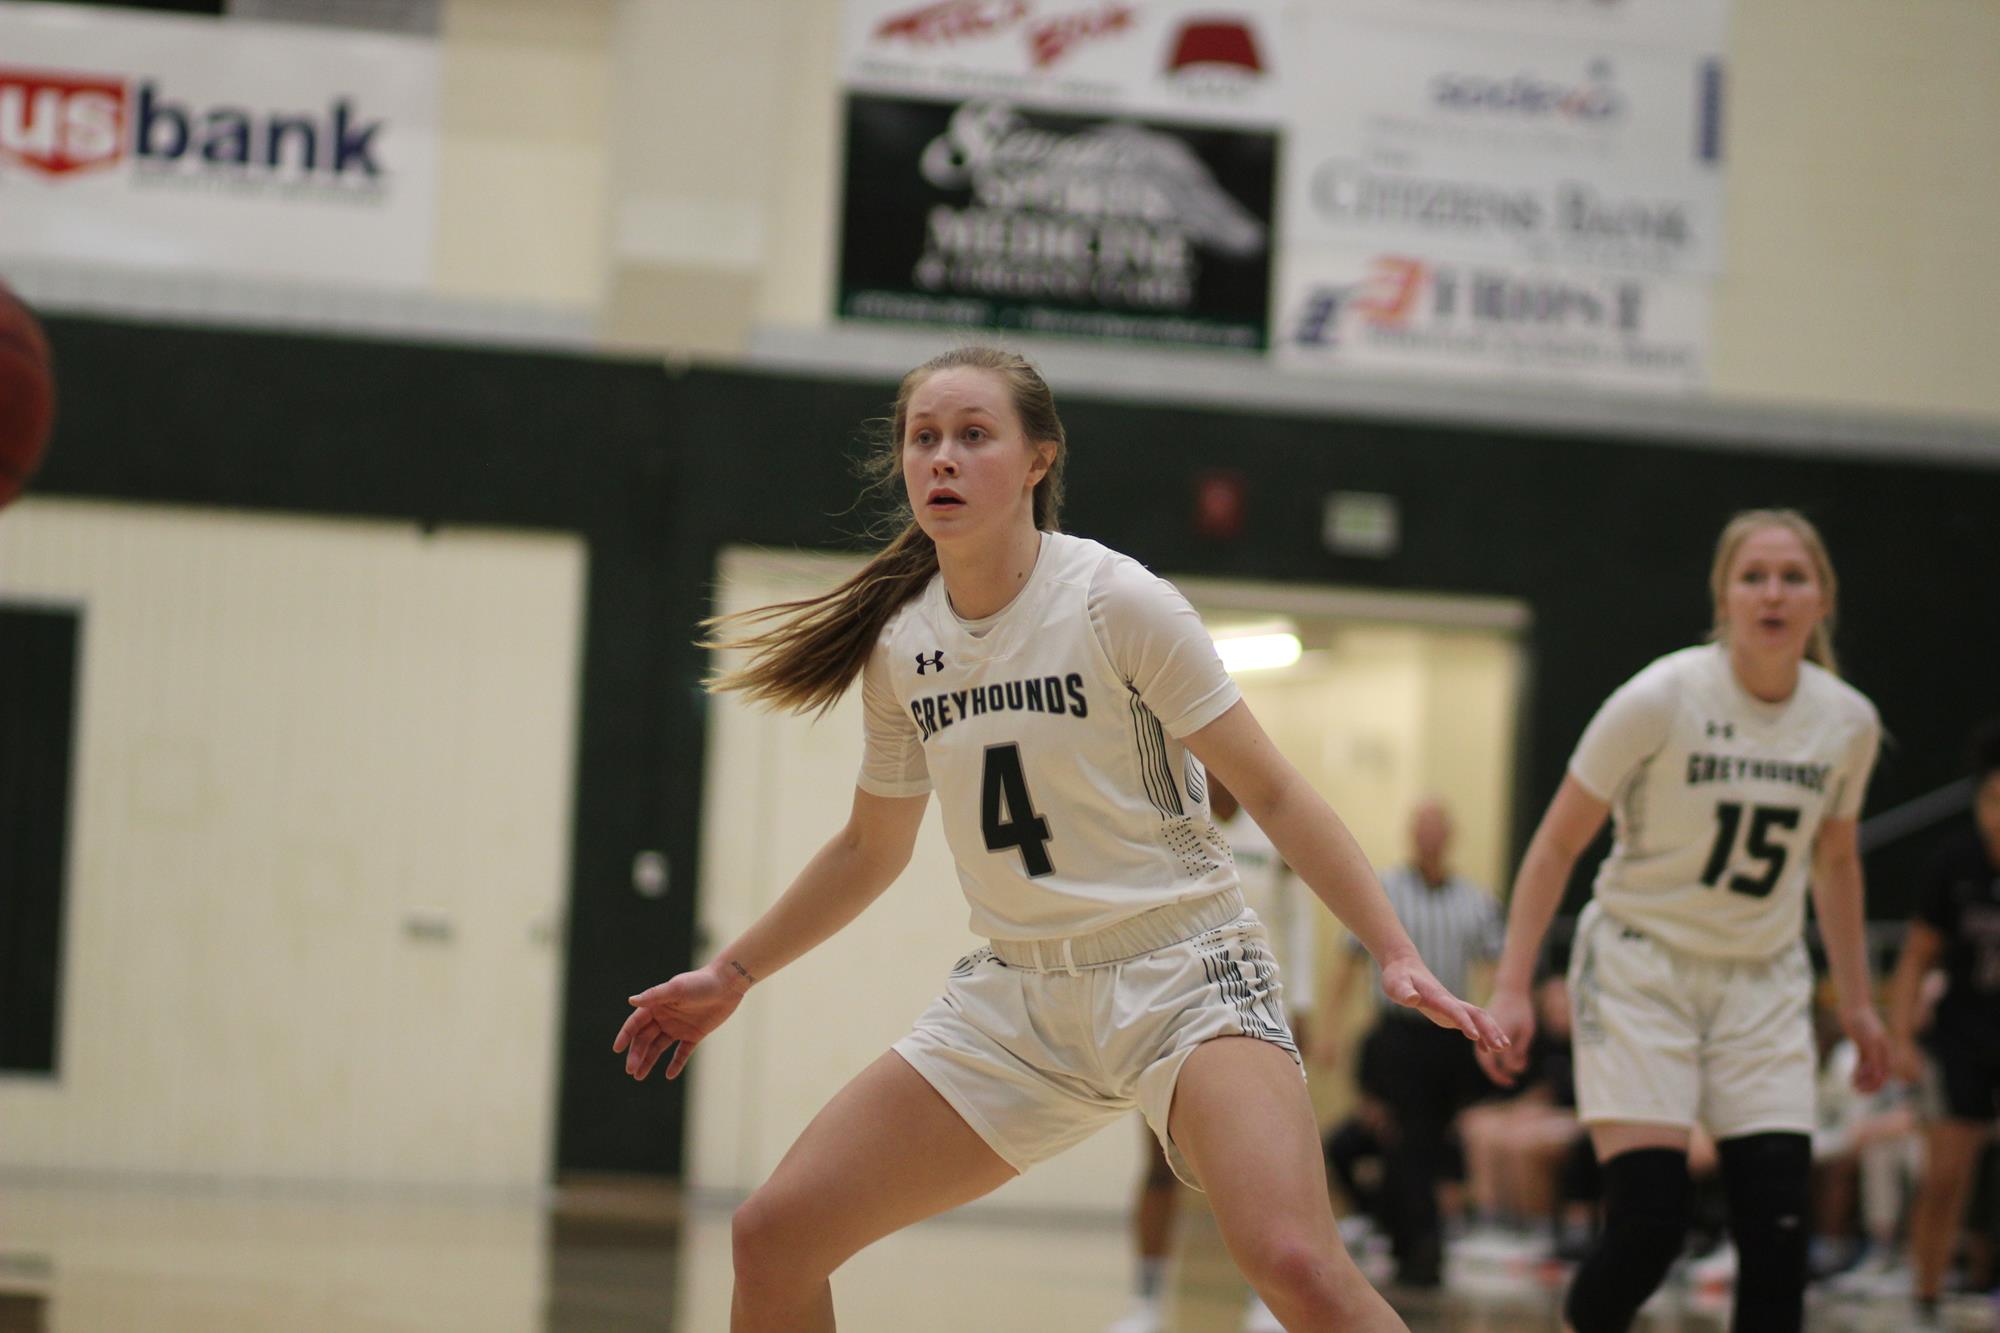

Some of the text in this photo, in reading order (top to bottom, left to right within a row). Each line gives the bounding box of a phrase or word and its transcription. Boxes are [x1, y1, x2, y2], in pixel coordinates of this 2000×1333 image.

[911, 672, 1088, 743] GREYHOUNDS
[980, 740, 1056, 880] 4
[1700, 801, 1802, 898] 15
